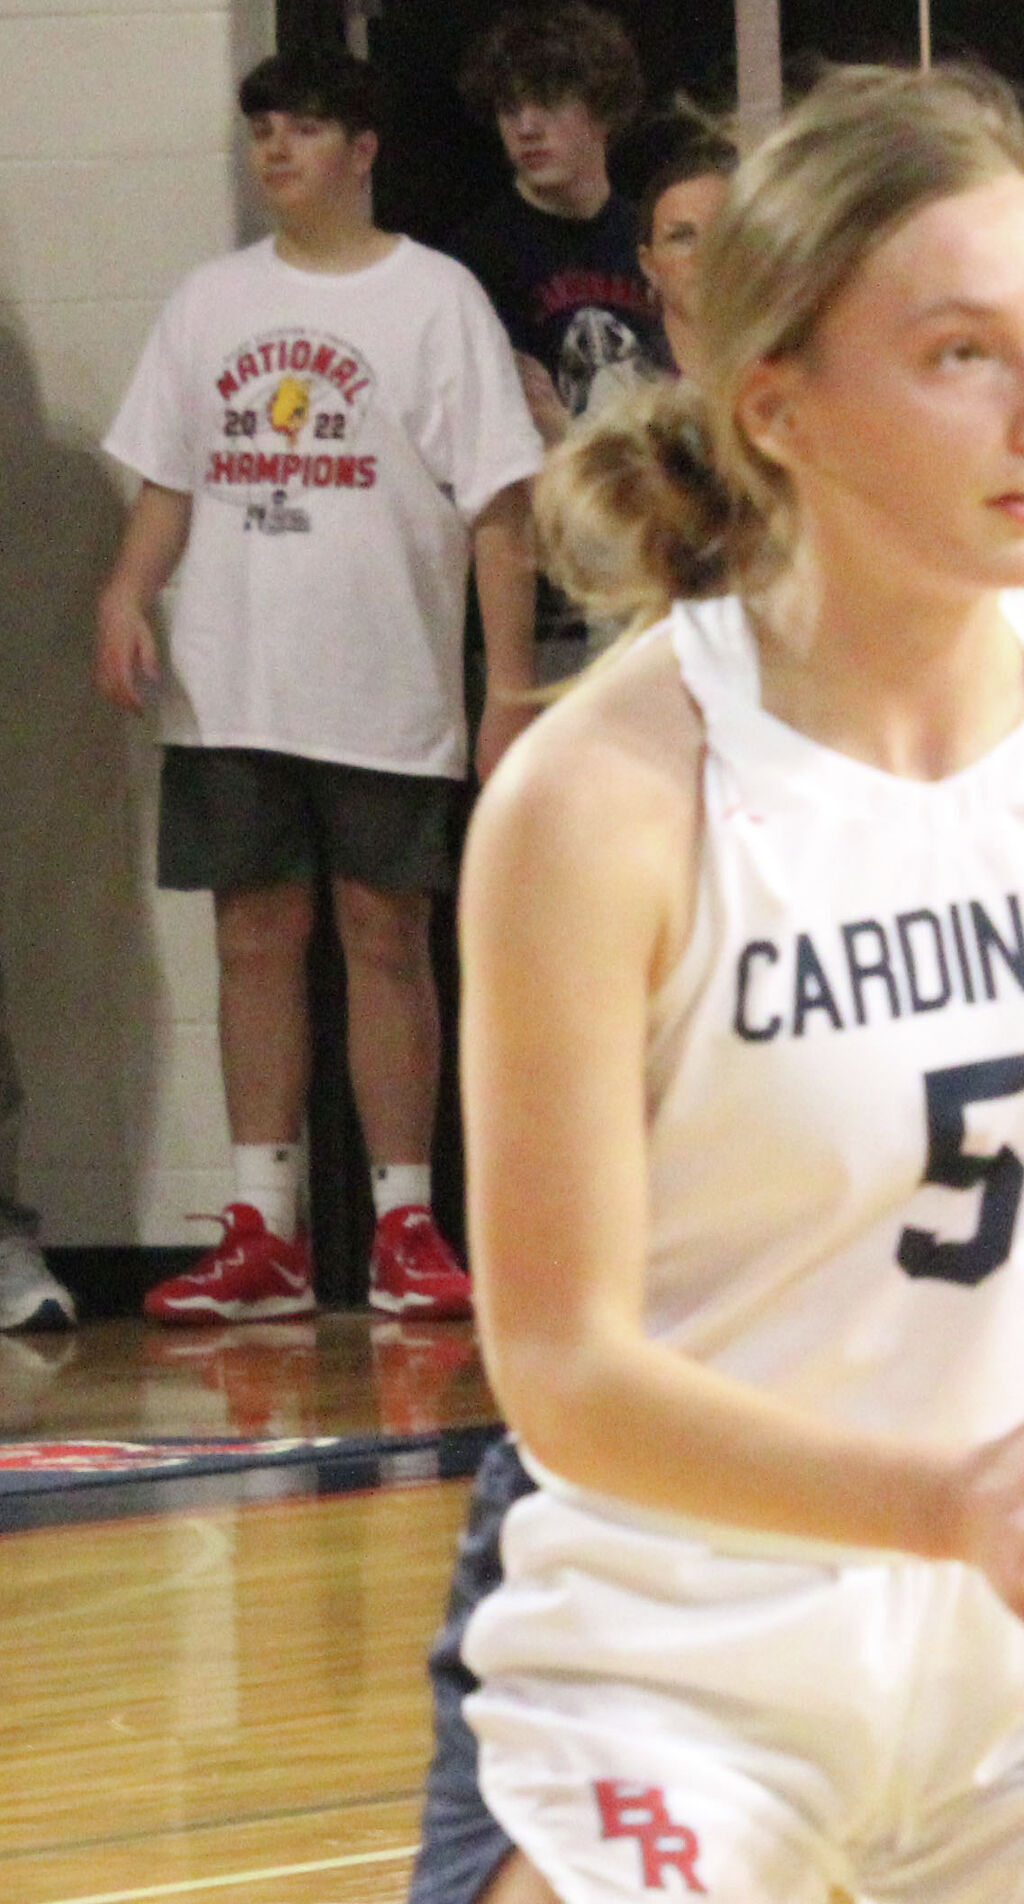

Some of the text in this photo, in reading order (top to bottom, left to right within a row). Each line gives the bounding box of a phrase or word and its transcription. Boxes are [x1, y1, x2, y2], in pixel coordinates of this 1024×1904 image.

[216, 339, 370, 406] NATIONAL
[223, 409, 346, 440] 20 22
[203, 451, 378, 489] HAMPIONS
